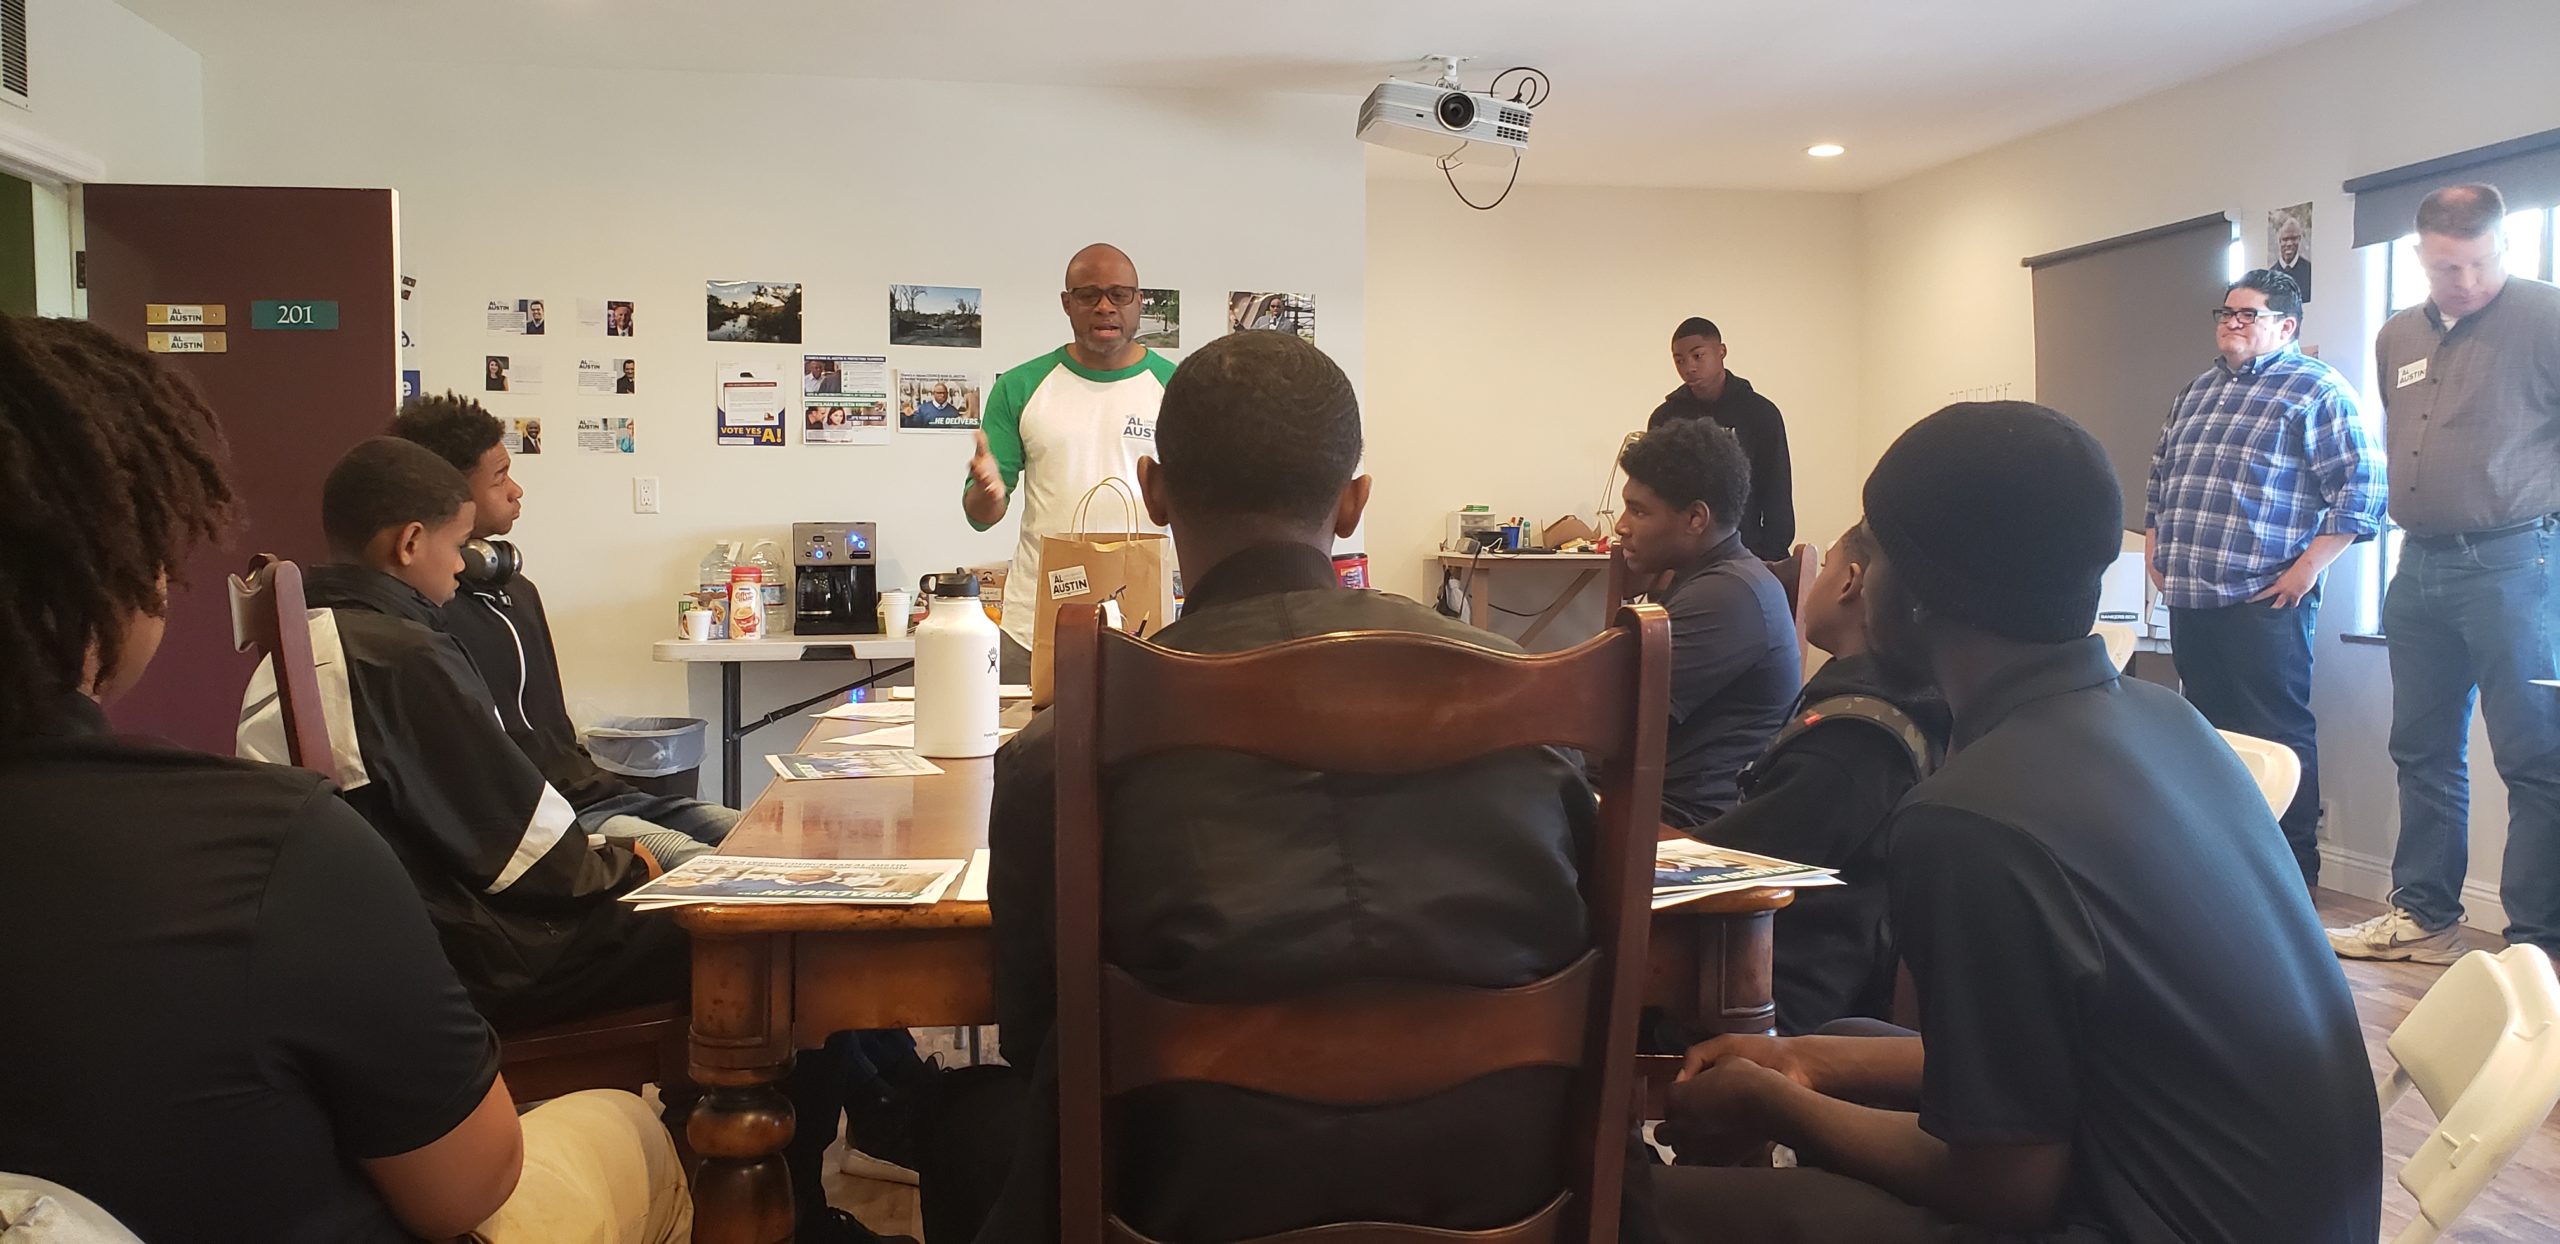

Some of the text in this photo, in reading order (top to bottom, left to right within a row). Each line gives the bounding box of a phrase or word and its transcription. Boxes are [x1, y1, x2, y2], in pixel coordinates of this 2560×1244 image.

[169, 314, 202, 322] AUSTIN
[277, 305, 314, 324] 201
[1128, 417, 1143, 426] AL
[745, 427, 762, 435] YES
[761, 428, 782, 443] A!
[1054, 574, 1064, 584] AL
[1053, 579, 1088, 594] AUSTIN
